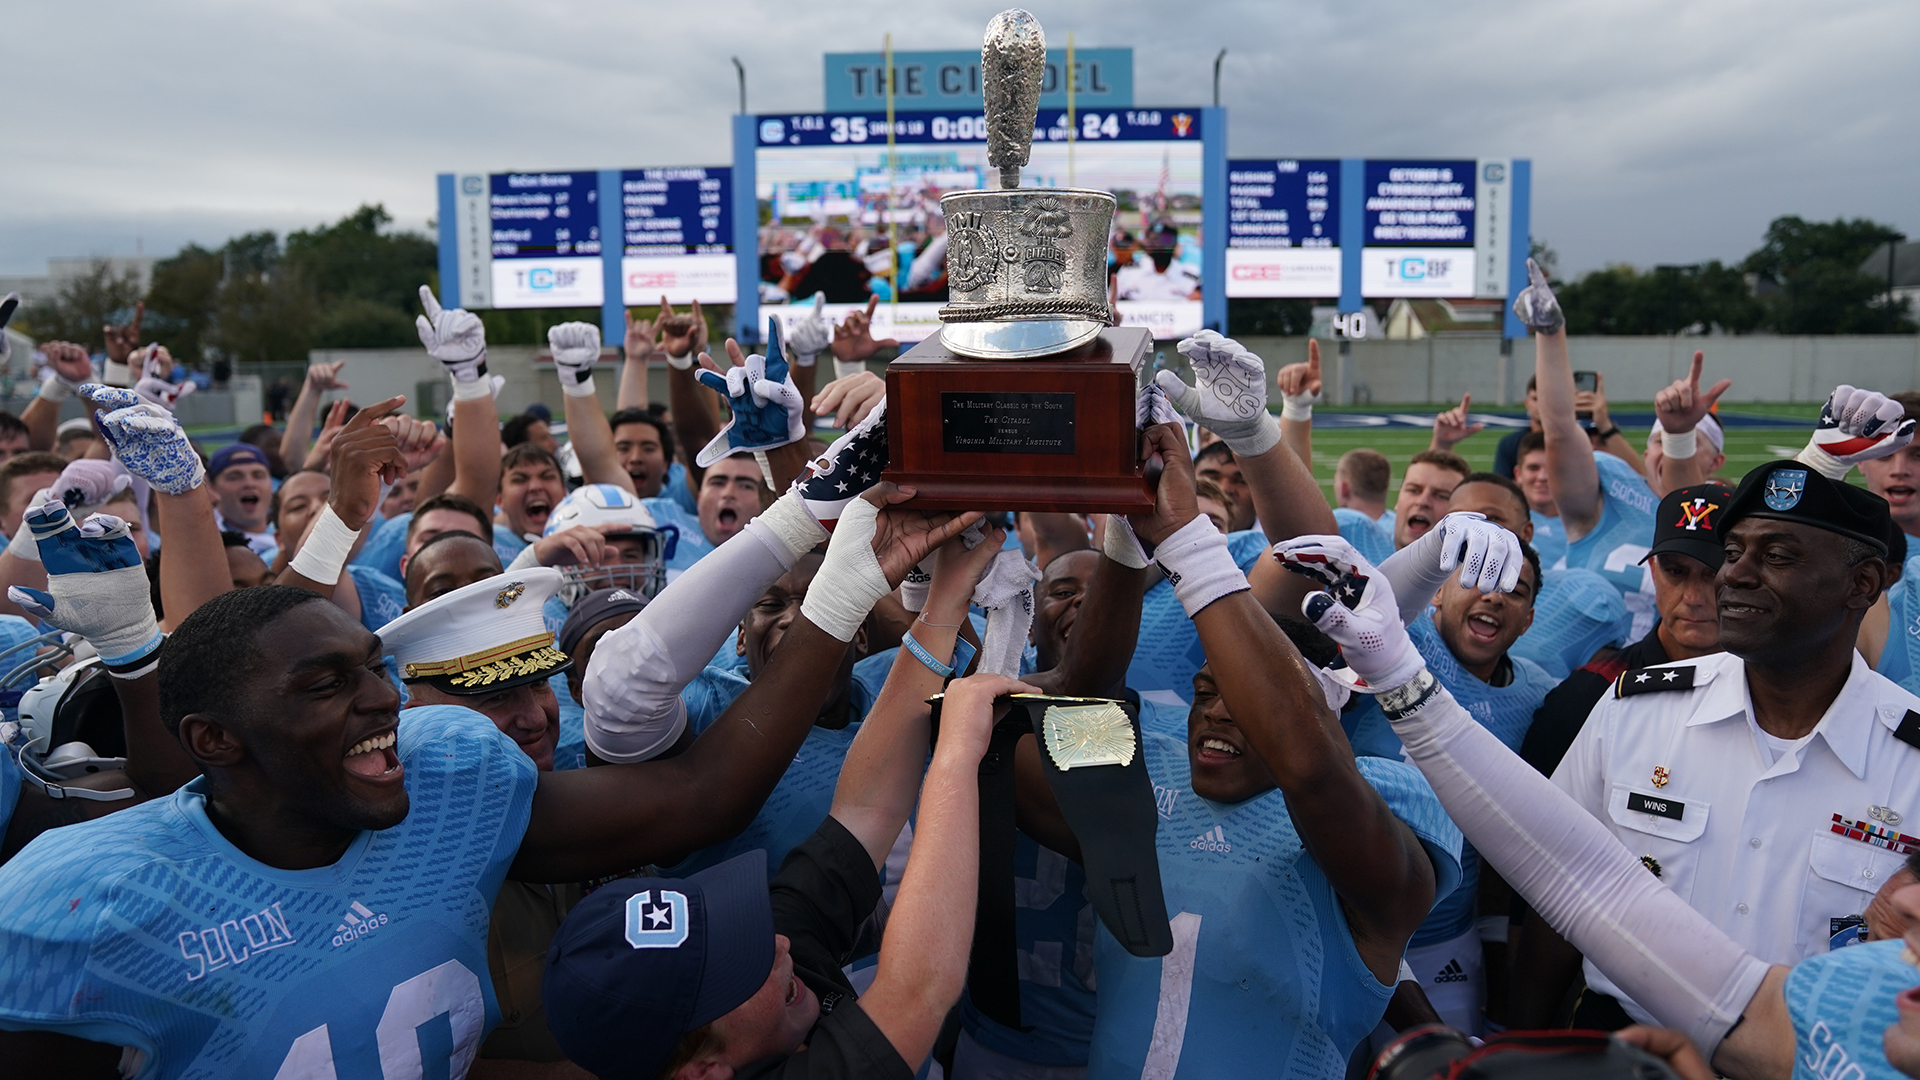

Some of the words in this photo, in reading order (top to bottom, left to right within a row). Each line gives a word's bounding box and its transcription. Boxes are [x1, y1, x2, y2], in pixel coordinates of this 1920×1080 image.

[849, 65, 923, 96] THE
[940, 63, 1107, 95] CIDEL
[830, 117, 868, 143] 35
[1082, 113, 1120, 139] 24
[1036, 235, 1057, 246] THE
[1026, 246, 1066, 263] CITADEL
[1333, 312, 1366, 338] 40
[966, 401, 993, 409] MILITARY
[995, 401, 1020, 409] CLASSIC
[1044, 401, 1063, 410] SOUTH
[984, 415, 999, 424] THE
[1001, 416, 1032, 425] CITADEL
[955, 436, 985, 446] VIRGINIA
[988, 436, 1023, 446] MILITARY
[1025, 437, 1062, 447] INSTITUTE
[1608, 478, 1655, 516] SOCON
[910, 642, 932, 665] Citadel
[1416, 631, 1460, 687] SOCON
[1399, 706, 1416, 719] Live
[1414, 700, 1424, 711] in
[1643, 799, 1667, 813] WINS
[1190, 838, 1232, 853] adidas
[332, 913, 388, 947] adidas
[178, 901, 296, 982] SOCON
[1435, 974, 1468, 984] adidas
